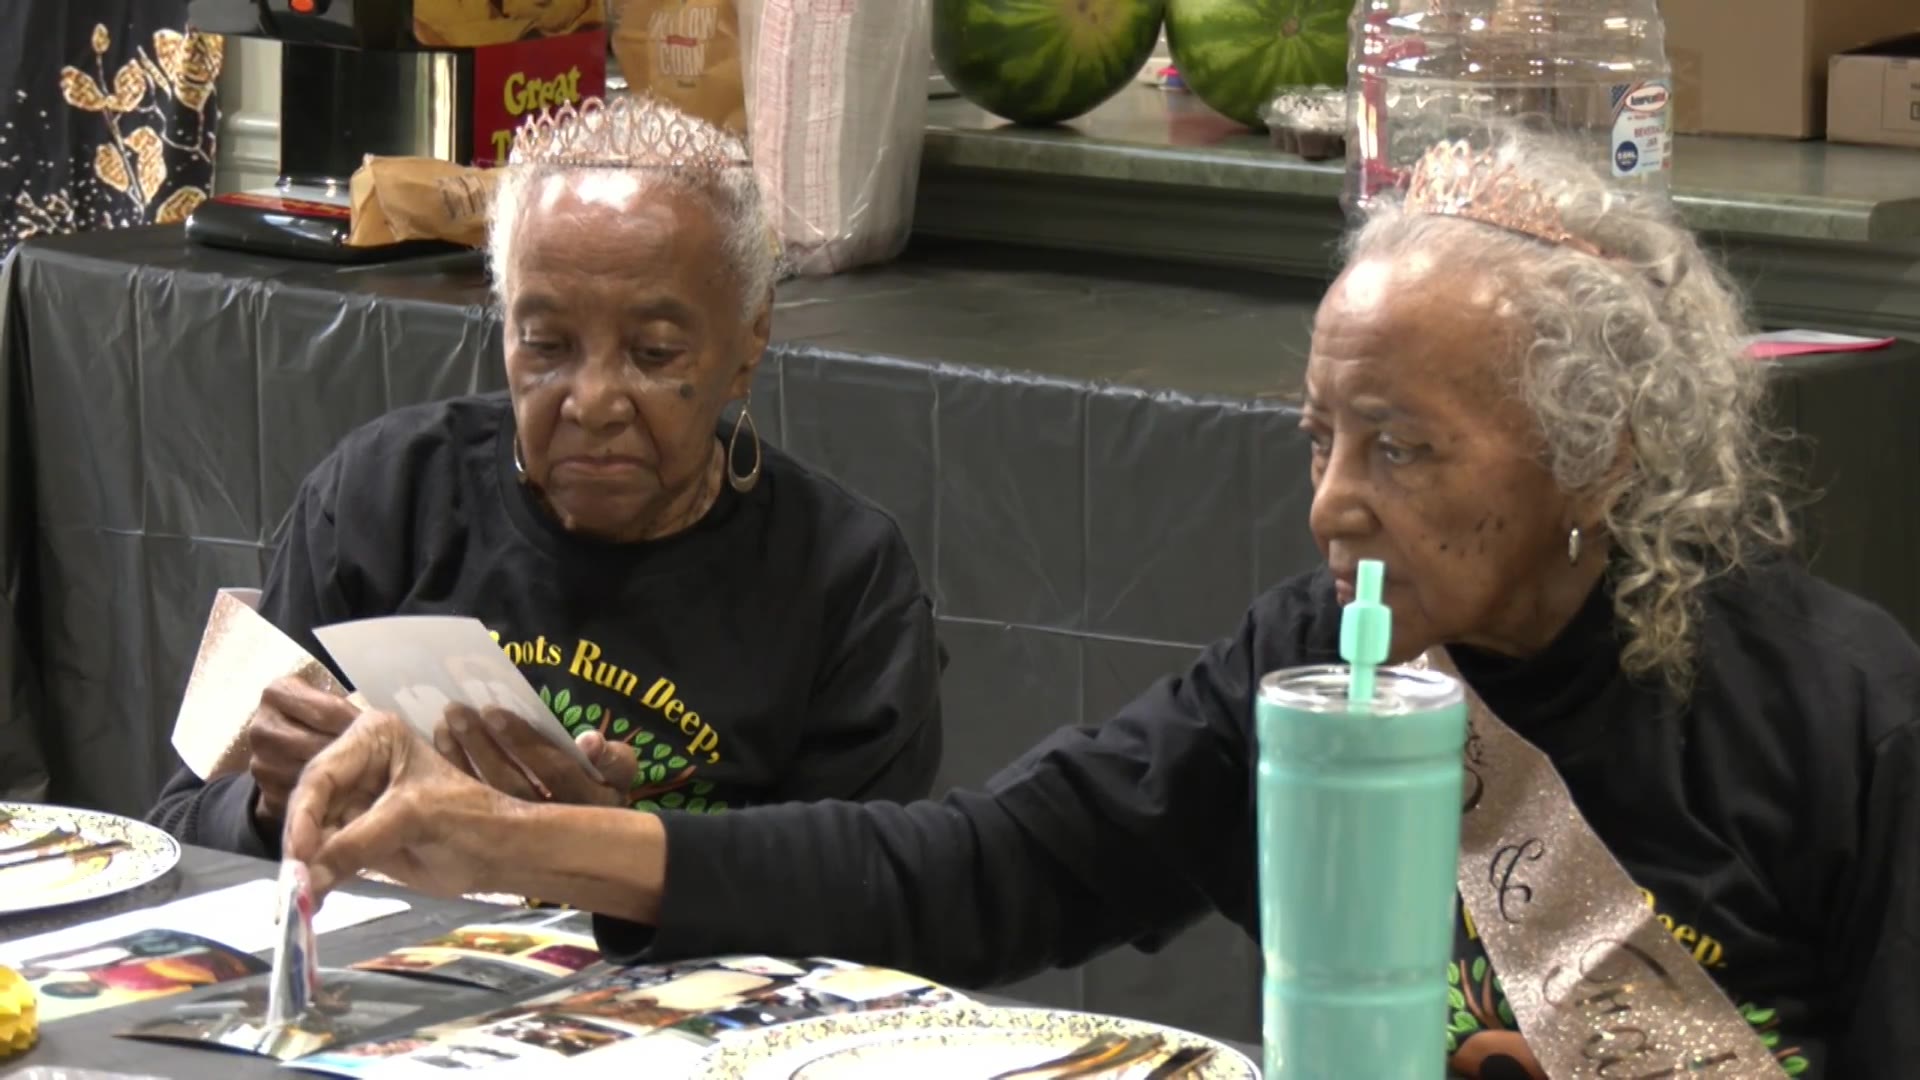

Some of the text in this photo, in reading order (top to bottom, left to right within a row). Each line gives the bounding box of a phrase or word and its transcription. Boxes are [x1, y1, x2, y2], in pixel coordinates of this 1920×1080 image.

[503, 65, 581, 116] Great
[489, 630, 721, 764] oots Run Deep,
